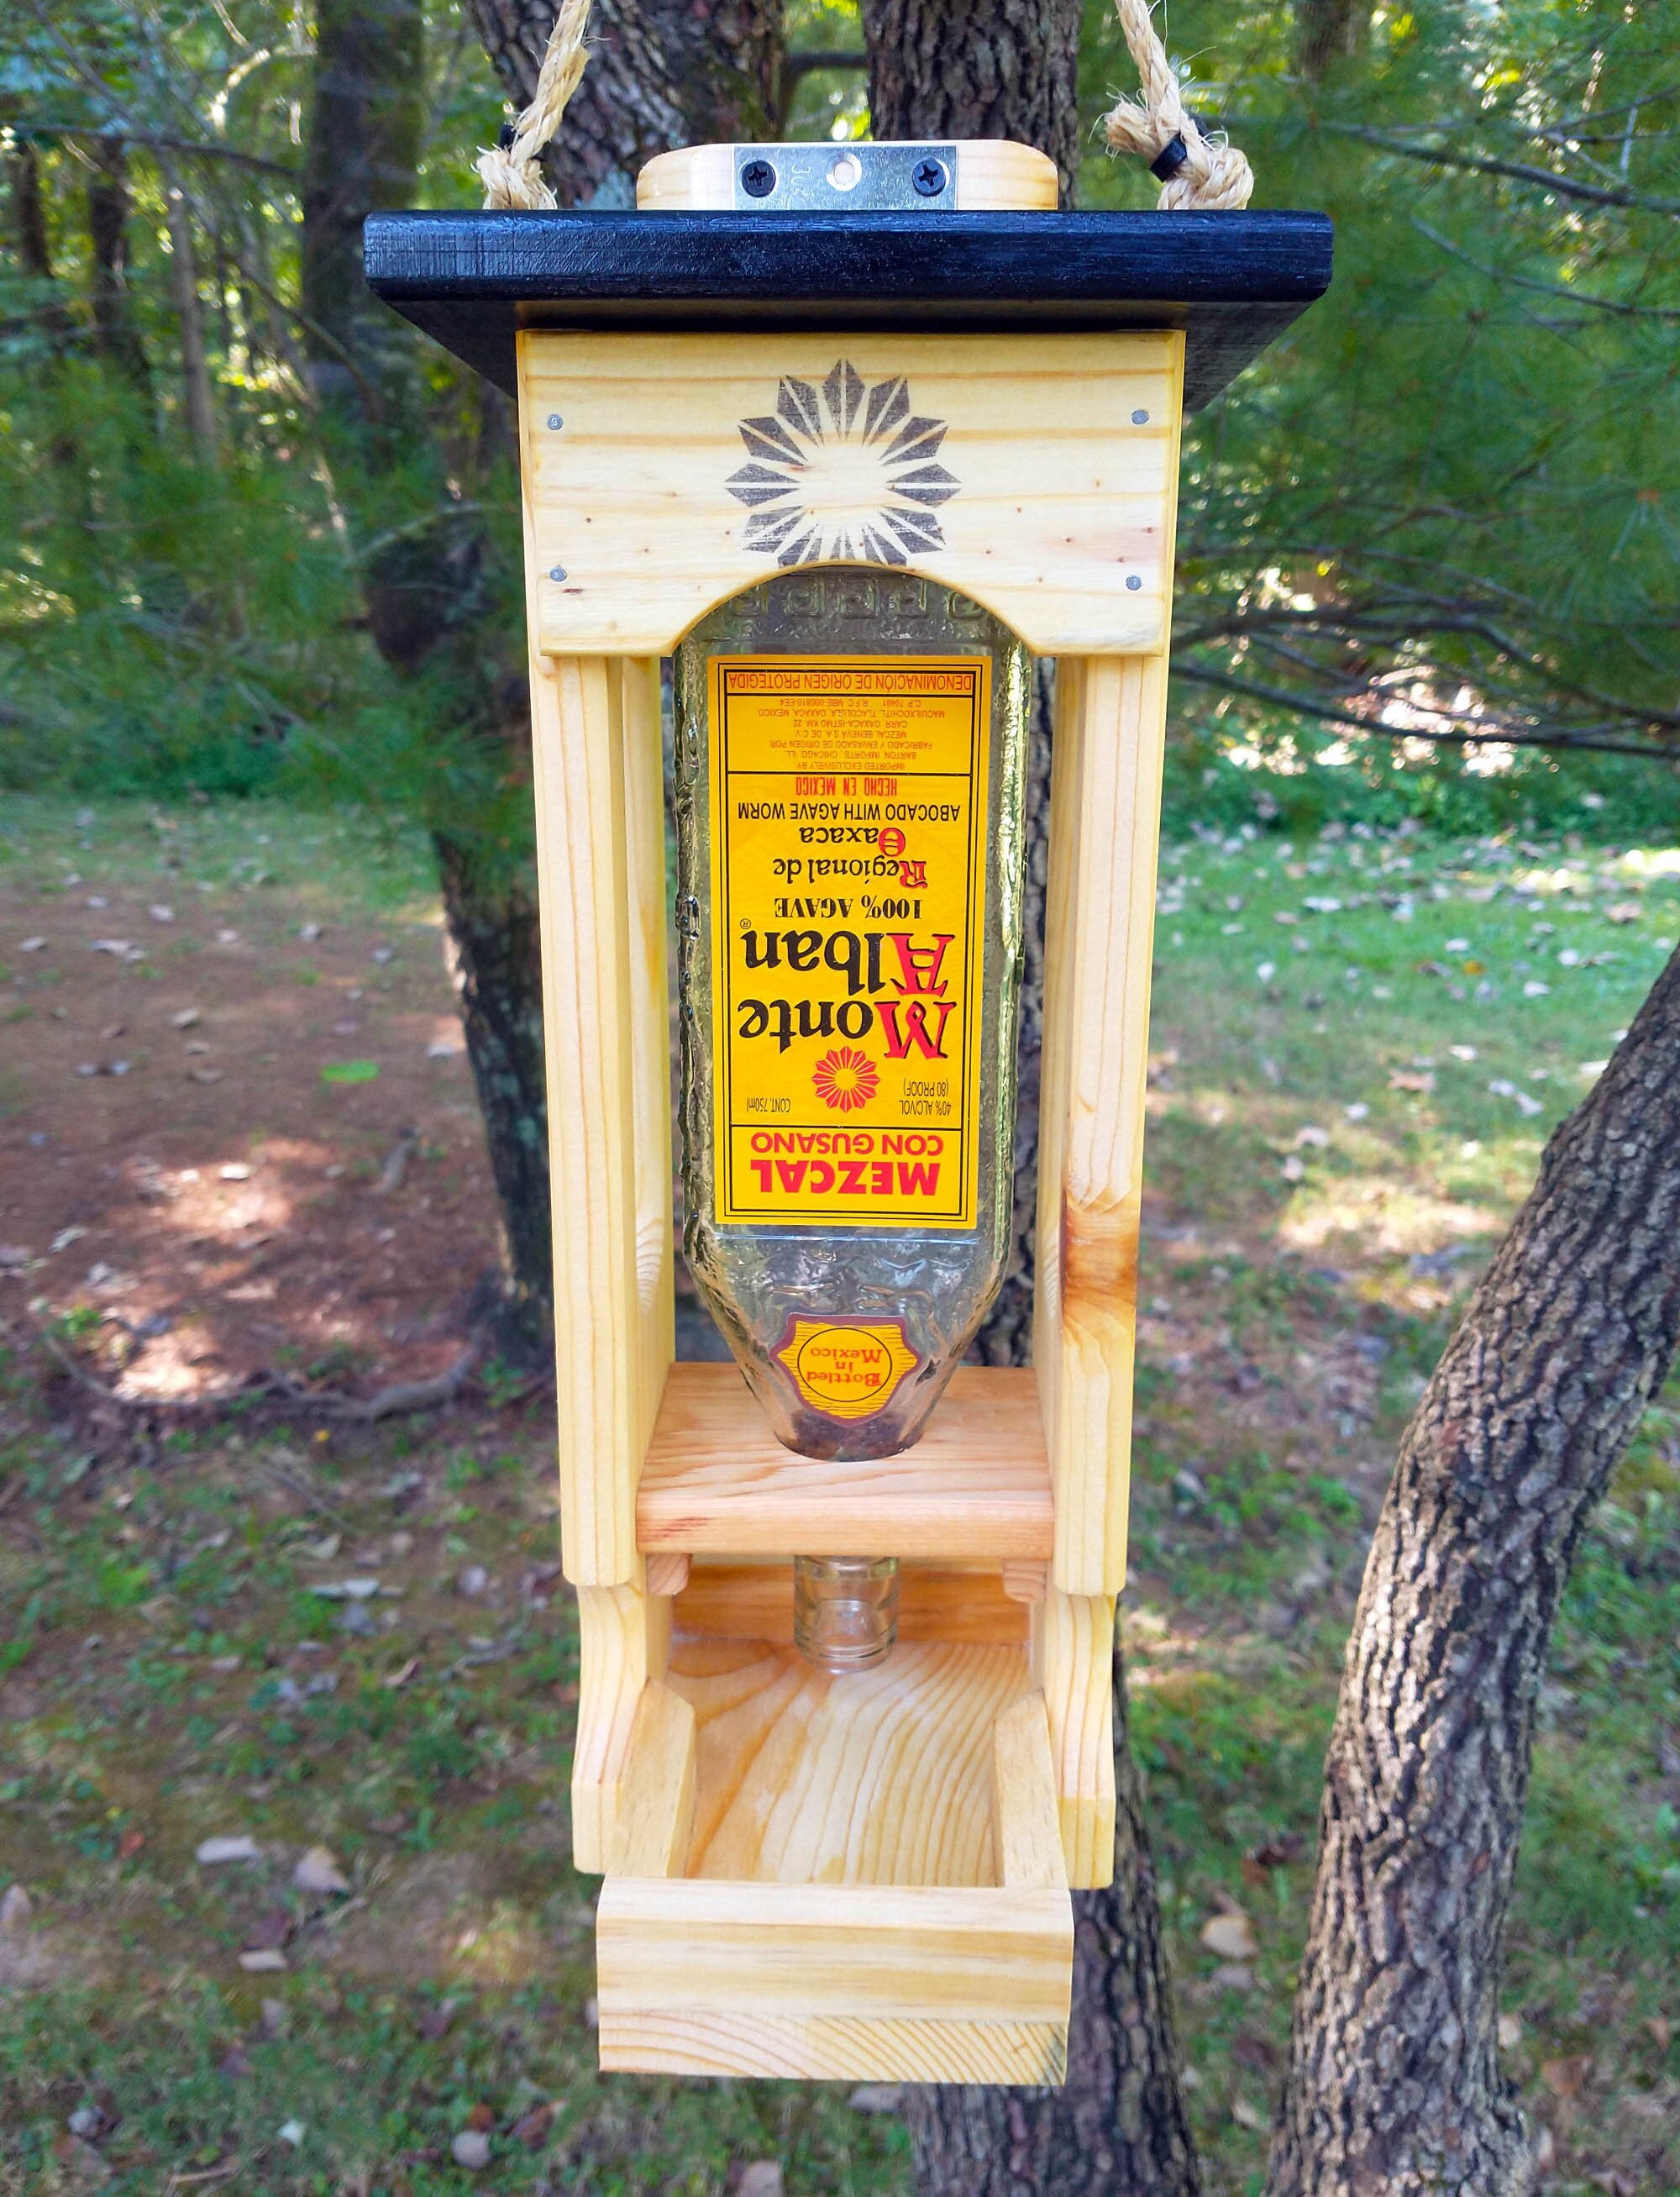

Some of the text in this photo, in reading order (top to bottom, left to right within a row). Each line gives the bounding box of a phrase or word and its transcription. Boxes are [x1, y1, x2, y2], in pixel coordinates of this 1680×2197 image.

[728, 673, 972, 693] DENOMINACIÓN DE ORIGEN PROTEGIDA
[883, 699, 905, 707] 70461
[820, 719, 881, 728] OAXACA-ISTMO
[875, 730, 907, 738] MEZCAL
[789, 739, 821, 749] ORIGEN
[822, 740, 833, 749] DE
[835, 740, 879, 749] ENVASADO
[886, 740, 933, 749] FABRICADO
[808, 761, 862, 770] EXCLUSIVELY
[864, 762, 906, 770] IMPORTED
[795, 776, 898, 796] HECHO EN MEXICO
[738, 802, 961, 822] ABOCADO WITH AGAVE WORM
[799, 827, 906, 857] Oaxaca
[773, 856, 927, 890] Regional de
[774, 895, 923, 920] 100% AGAVE
[739, 929, 956, 998] Alban
[737, 999, 958, 1060] Monte
[903, 1078, 949, 1097] (80 PROOF)
[746, 1097, 769, 1112] 750ml
[899, 1100, 952, 1116] 40% ALC/VOL
[750, 1132, 944, 1156] CON GUSANO
[750, 1159, 941, 1196] MEZCAL
[810, 1348, 883, 1364] Mexico
[835, 1362, 853, 1372] in
[806, 1371, 882, 1387] Bottled
